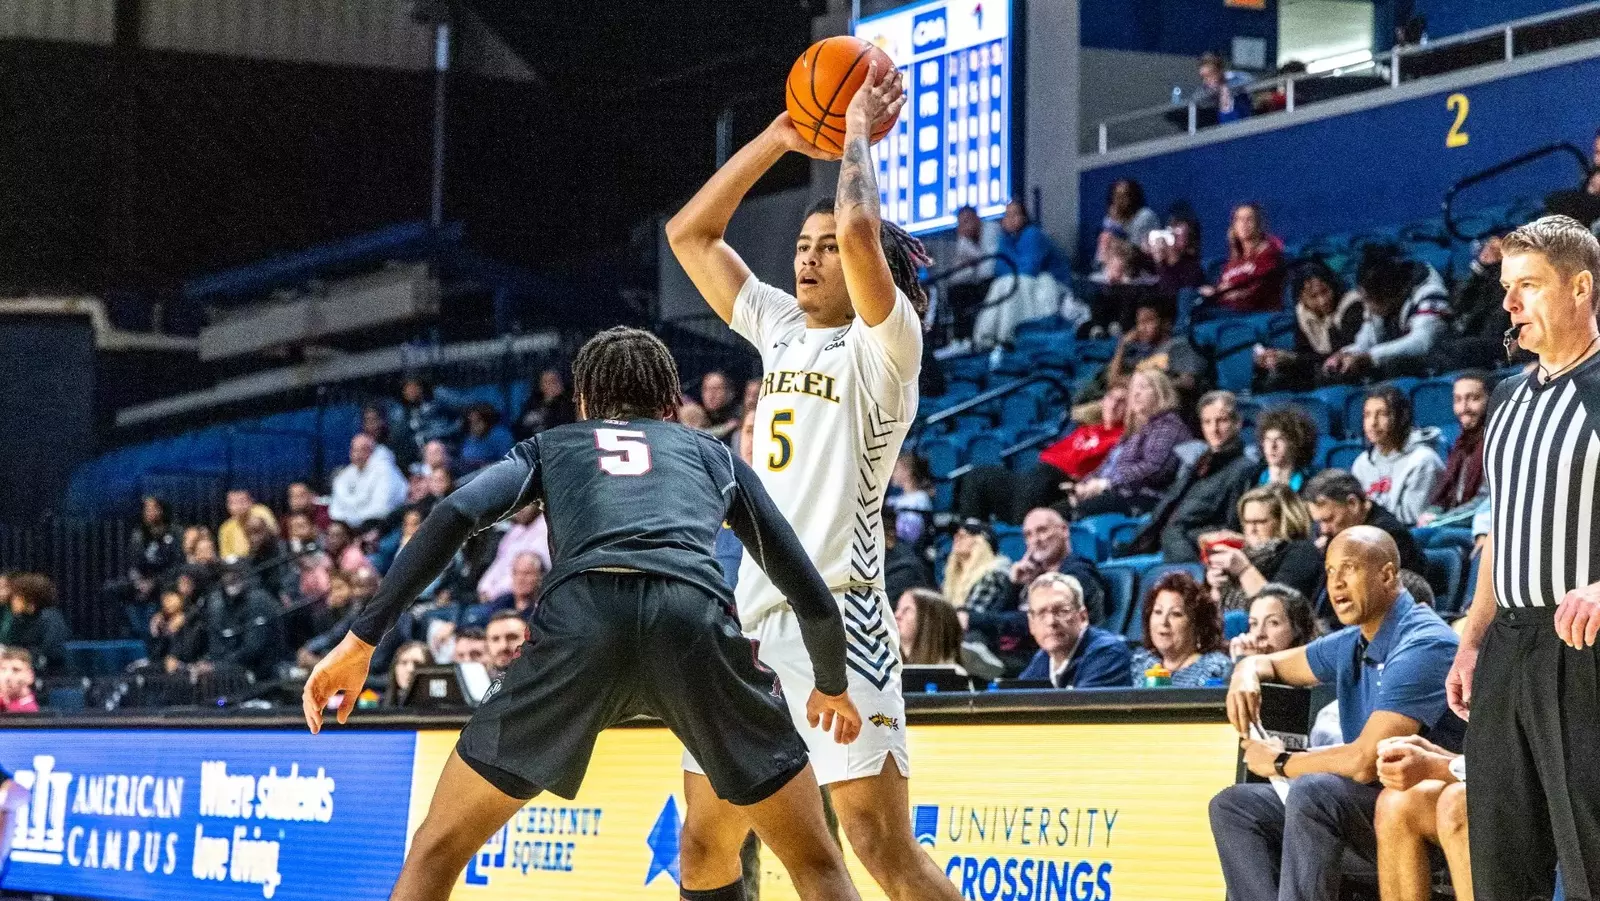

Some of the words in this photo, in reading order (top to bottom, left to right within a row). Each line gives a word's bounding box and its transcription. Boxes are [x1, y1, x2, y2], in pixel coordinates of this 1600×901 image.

[1446, 93, 1469, 148] 2
[824, 340, 846, 351] CAA
[594, 428, 652, 477] 5
[767, 408, 795, 472] 5
[73, 775, 184, 817] AMERICAN
[200, 761, 256, 818] Where
[256, 762, 335, 823] students
[516, 807, 602, 835] CHESTNUT
[949, 806, 1119, 848] UNIVERSITY
[67, 826, 179, 875] CAMPUS
[512, 841, 575, 874] SQUARE
[946, 855, 1112, 901] CROSSINGS
